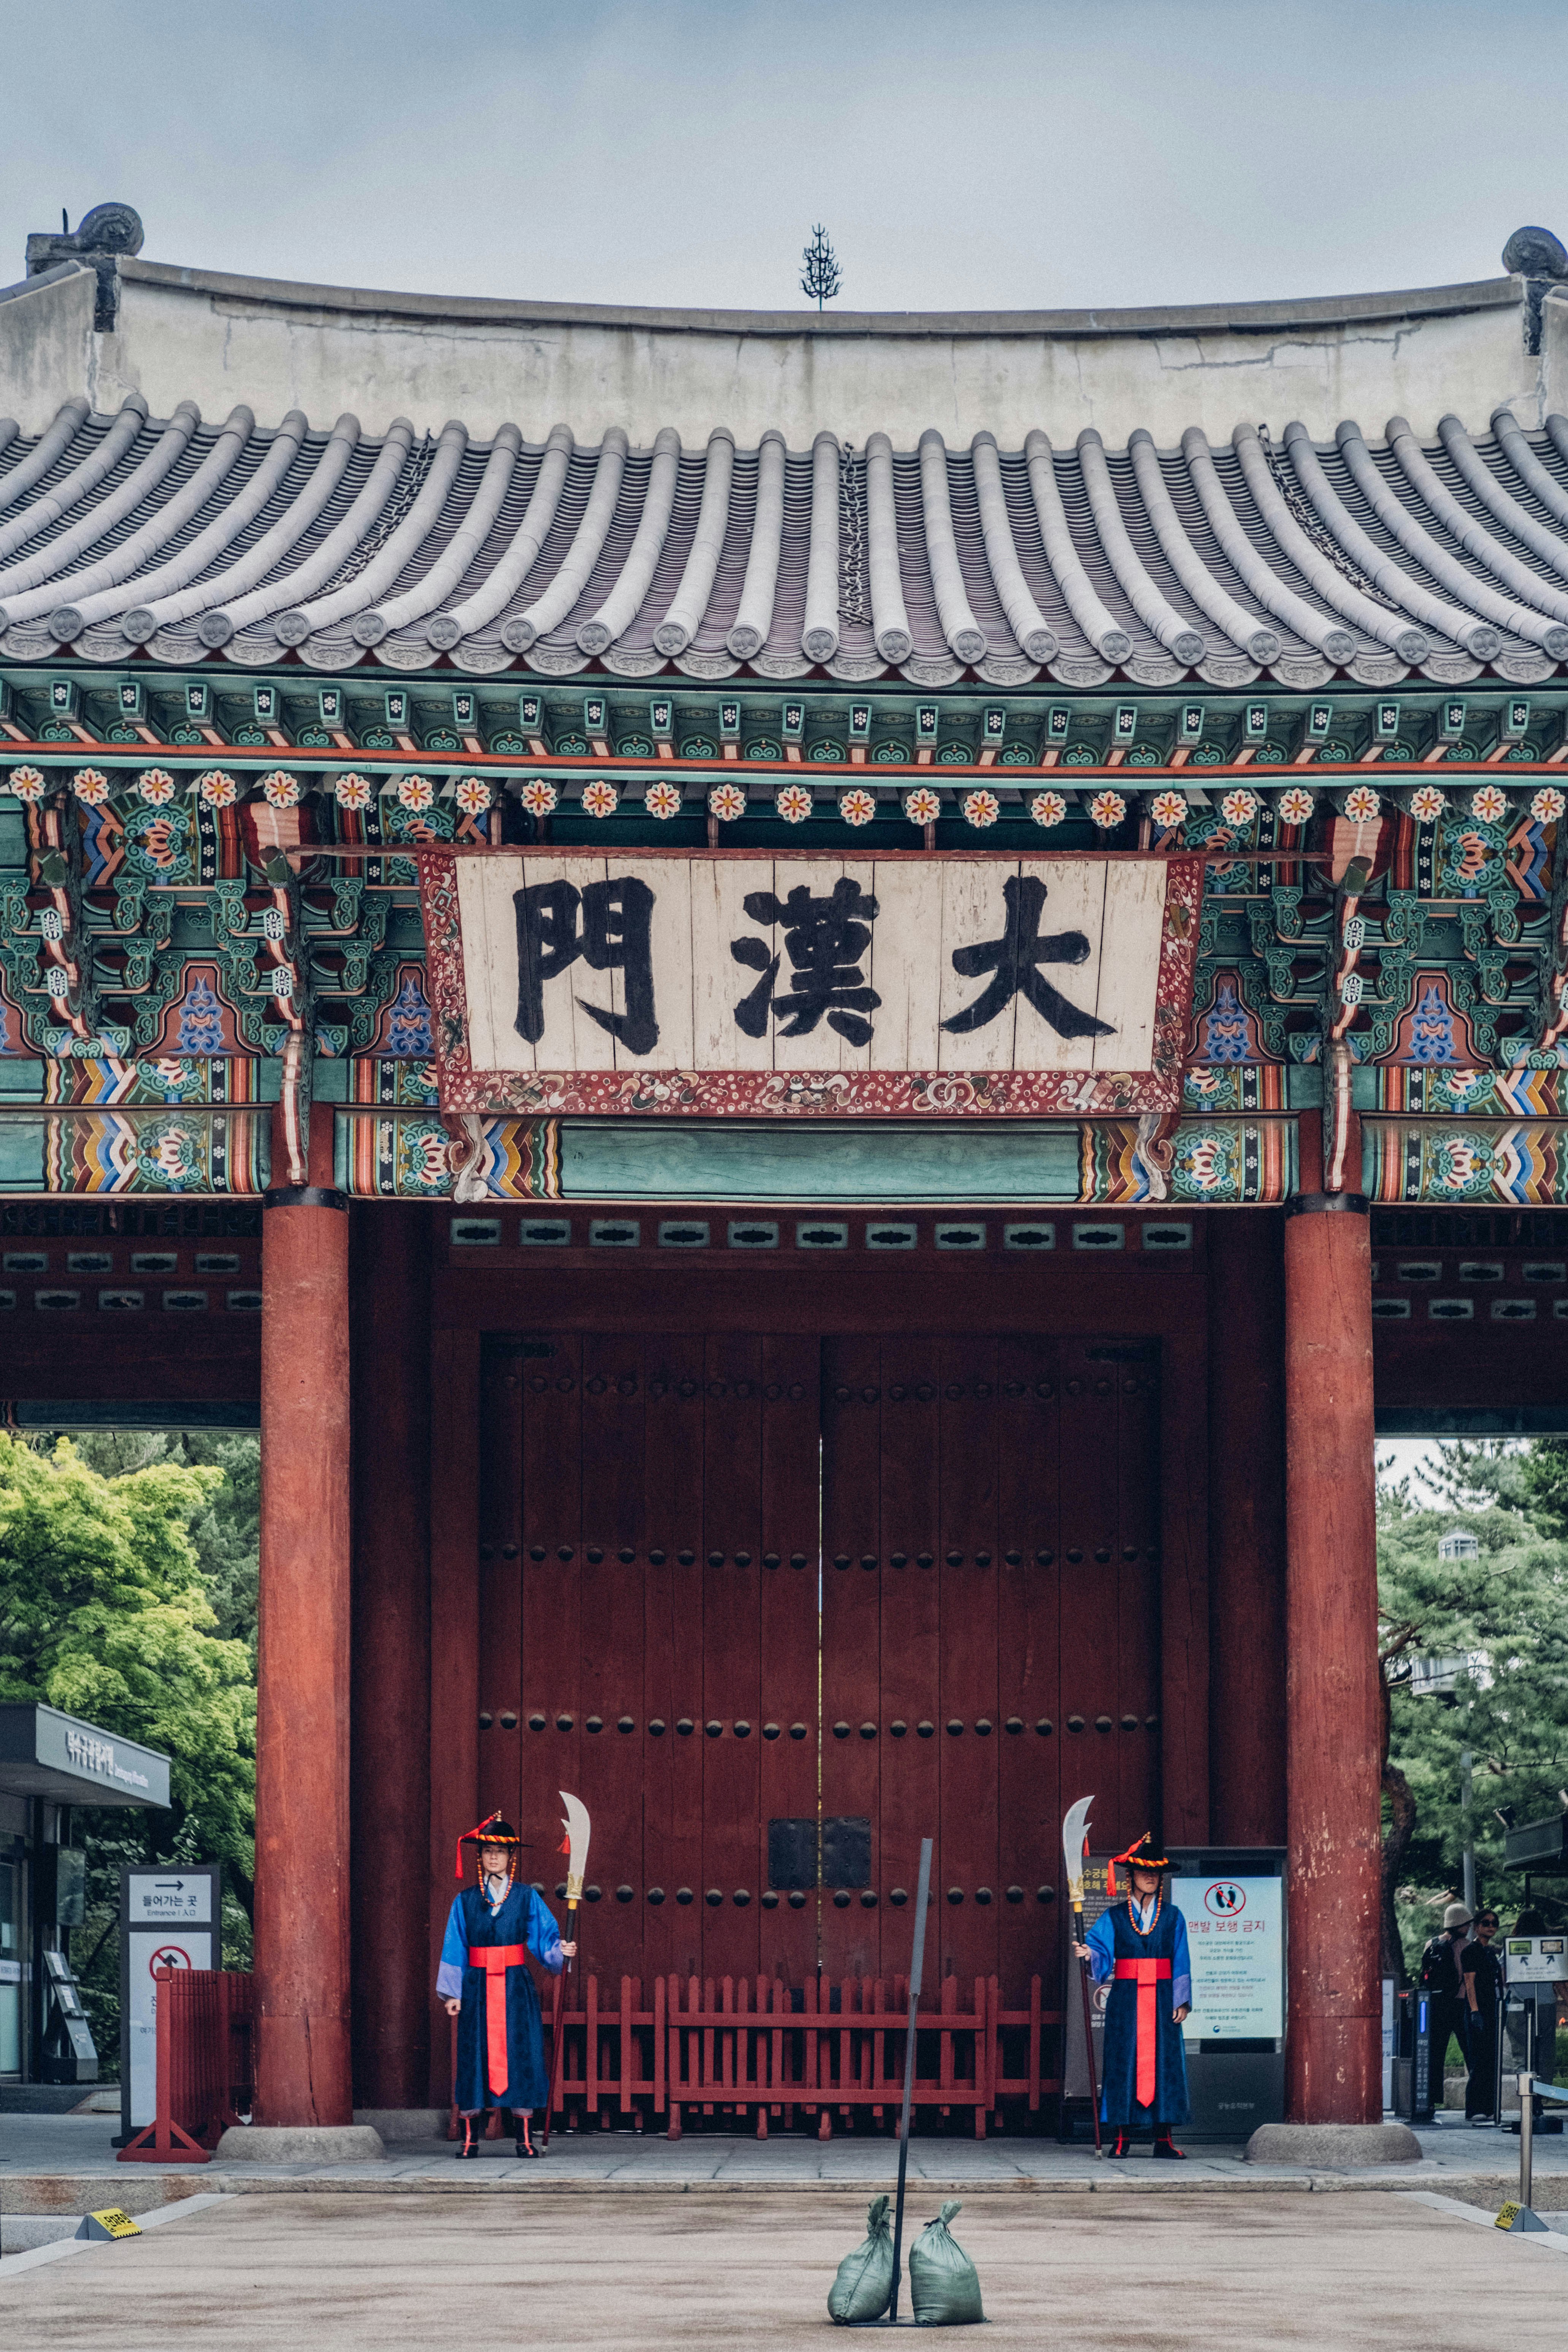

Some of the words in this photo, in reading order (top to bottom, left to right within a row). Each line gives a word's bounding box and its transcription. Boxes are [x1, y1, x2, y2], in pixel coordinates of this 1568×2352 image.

[1084, 1869, 1108, 1878] 수궁을
[1084, 1881, 1100, 1890] 호해
[143, 1895, 183, 1906] 들어가는
[187, 1895, 197, 1906] 곳
[1189, 1921, 1211, 1933] 맨발
[1216, 1920, 1238, 1933] 보행
[1242, 1920, 1265, 1933] 금지
[103, 2213, 132, 2227] 단차주의
